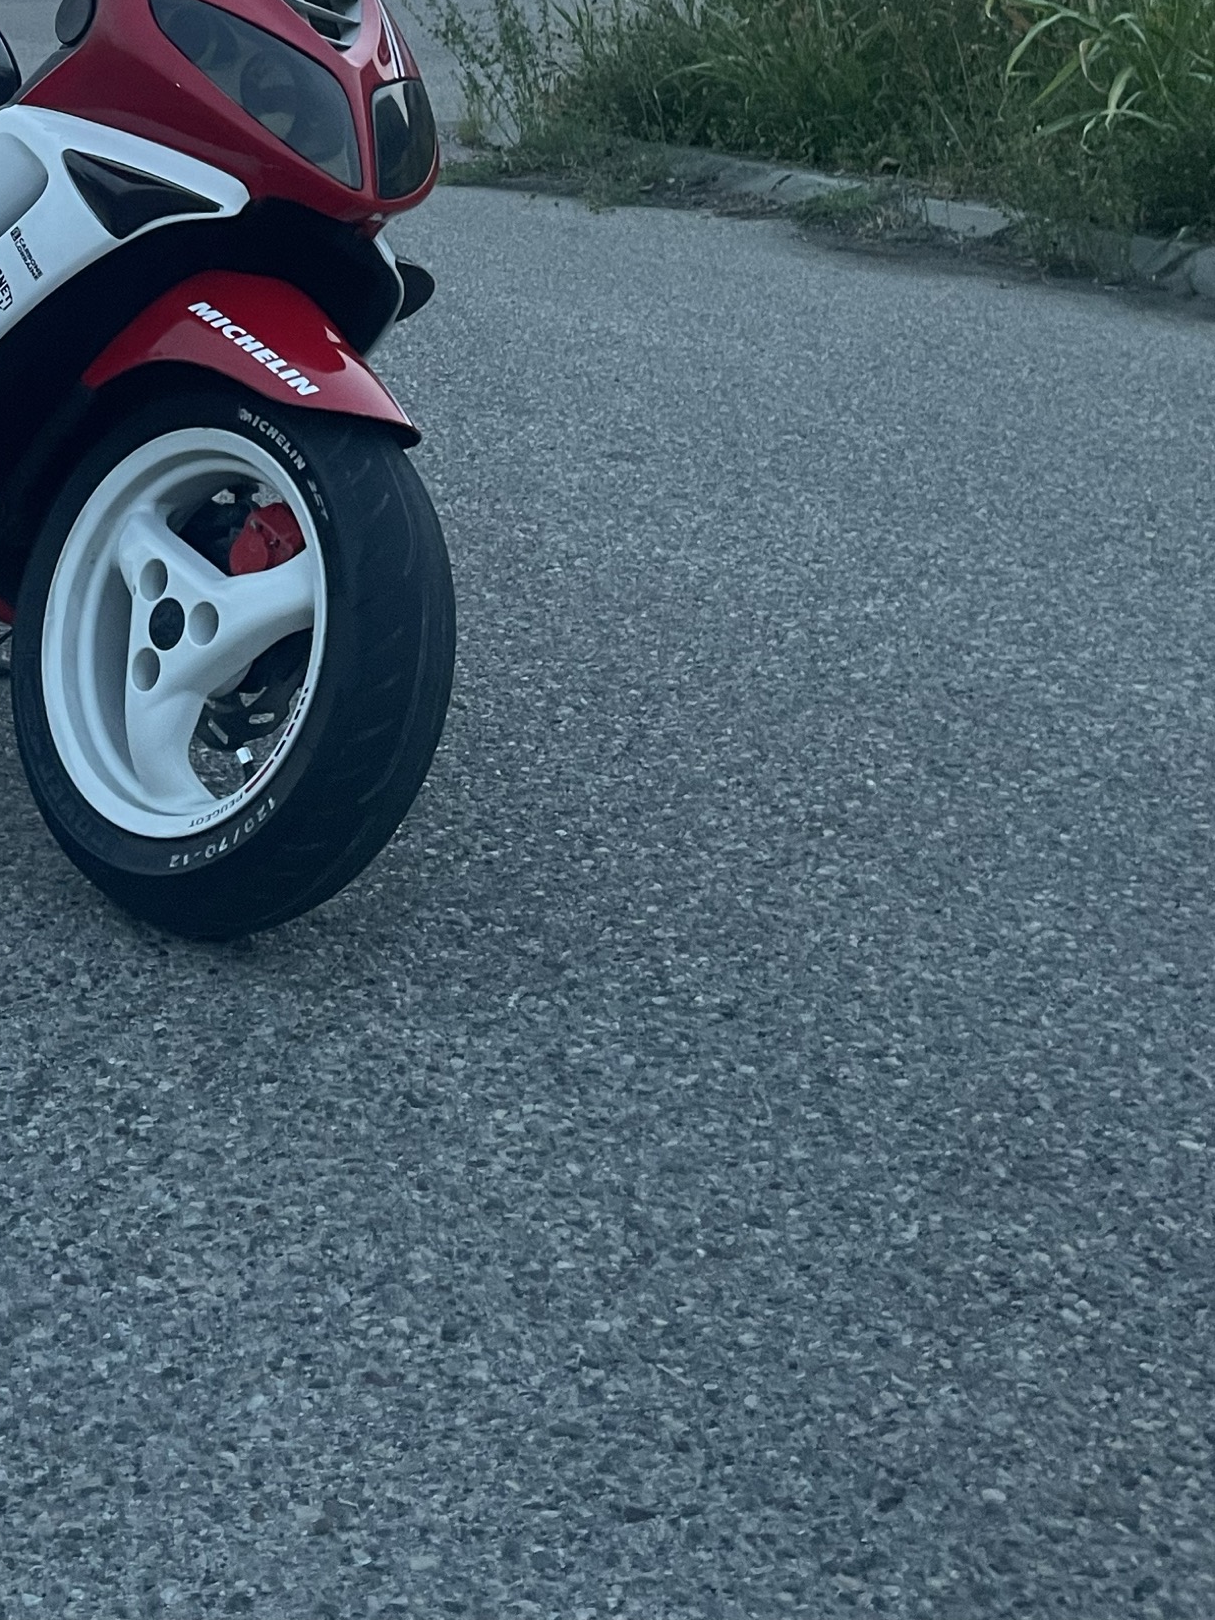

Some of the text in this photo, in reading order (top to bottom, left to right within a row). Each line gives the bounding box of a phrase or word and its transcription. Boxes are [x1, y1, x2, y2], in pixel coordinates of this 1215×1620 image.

[18, 237, 44, 277] CARBONE
[187, 301, 320, 396] MICHELIN
[239, 408, 306, 471] MICHELIN
[169, 796, 276, 869] 120/70-12
[187, 792, 244, 829] PEUGEOT
